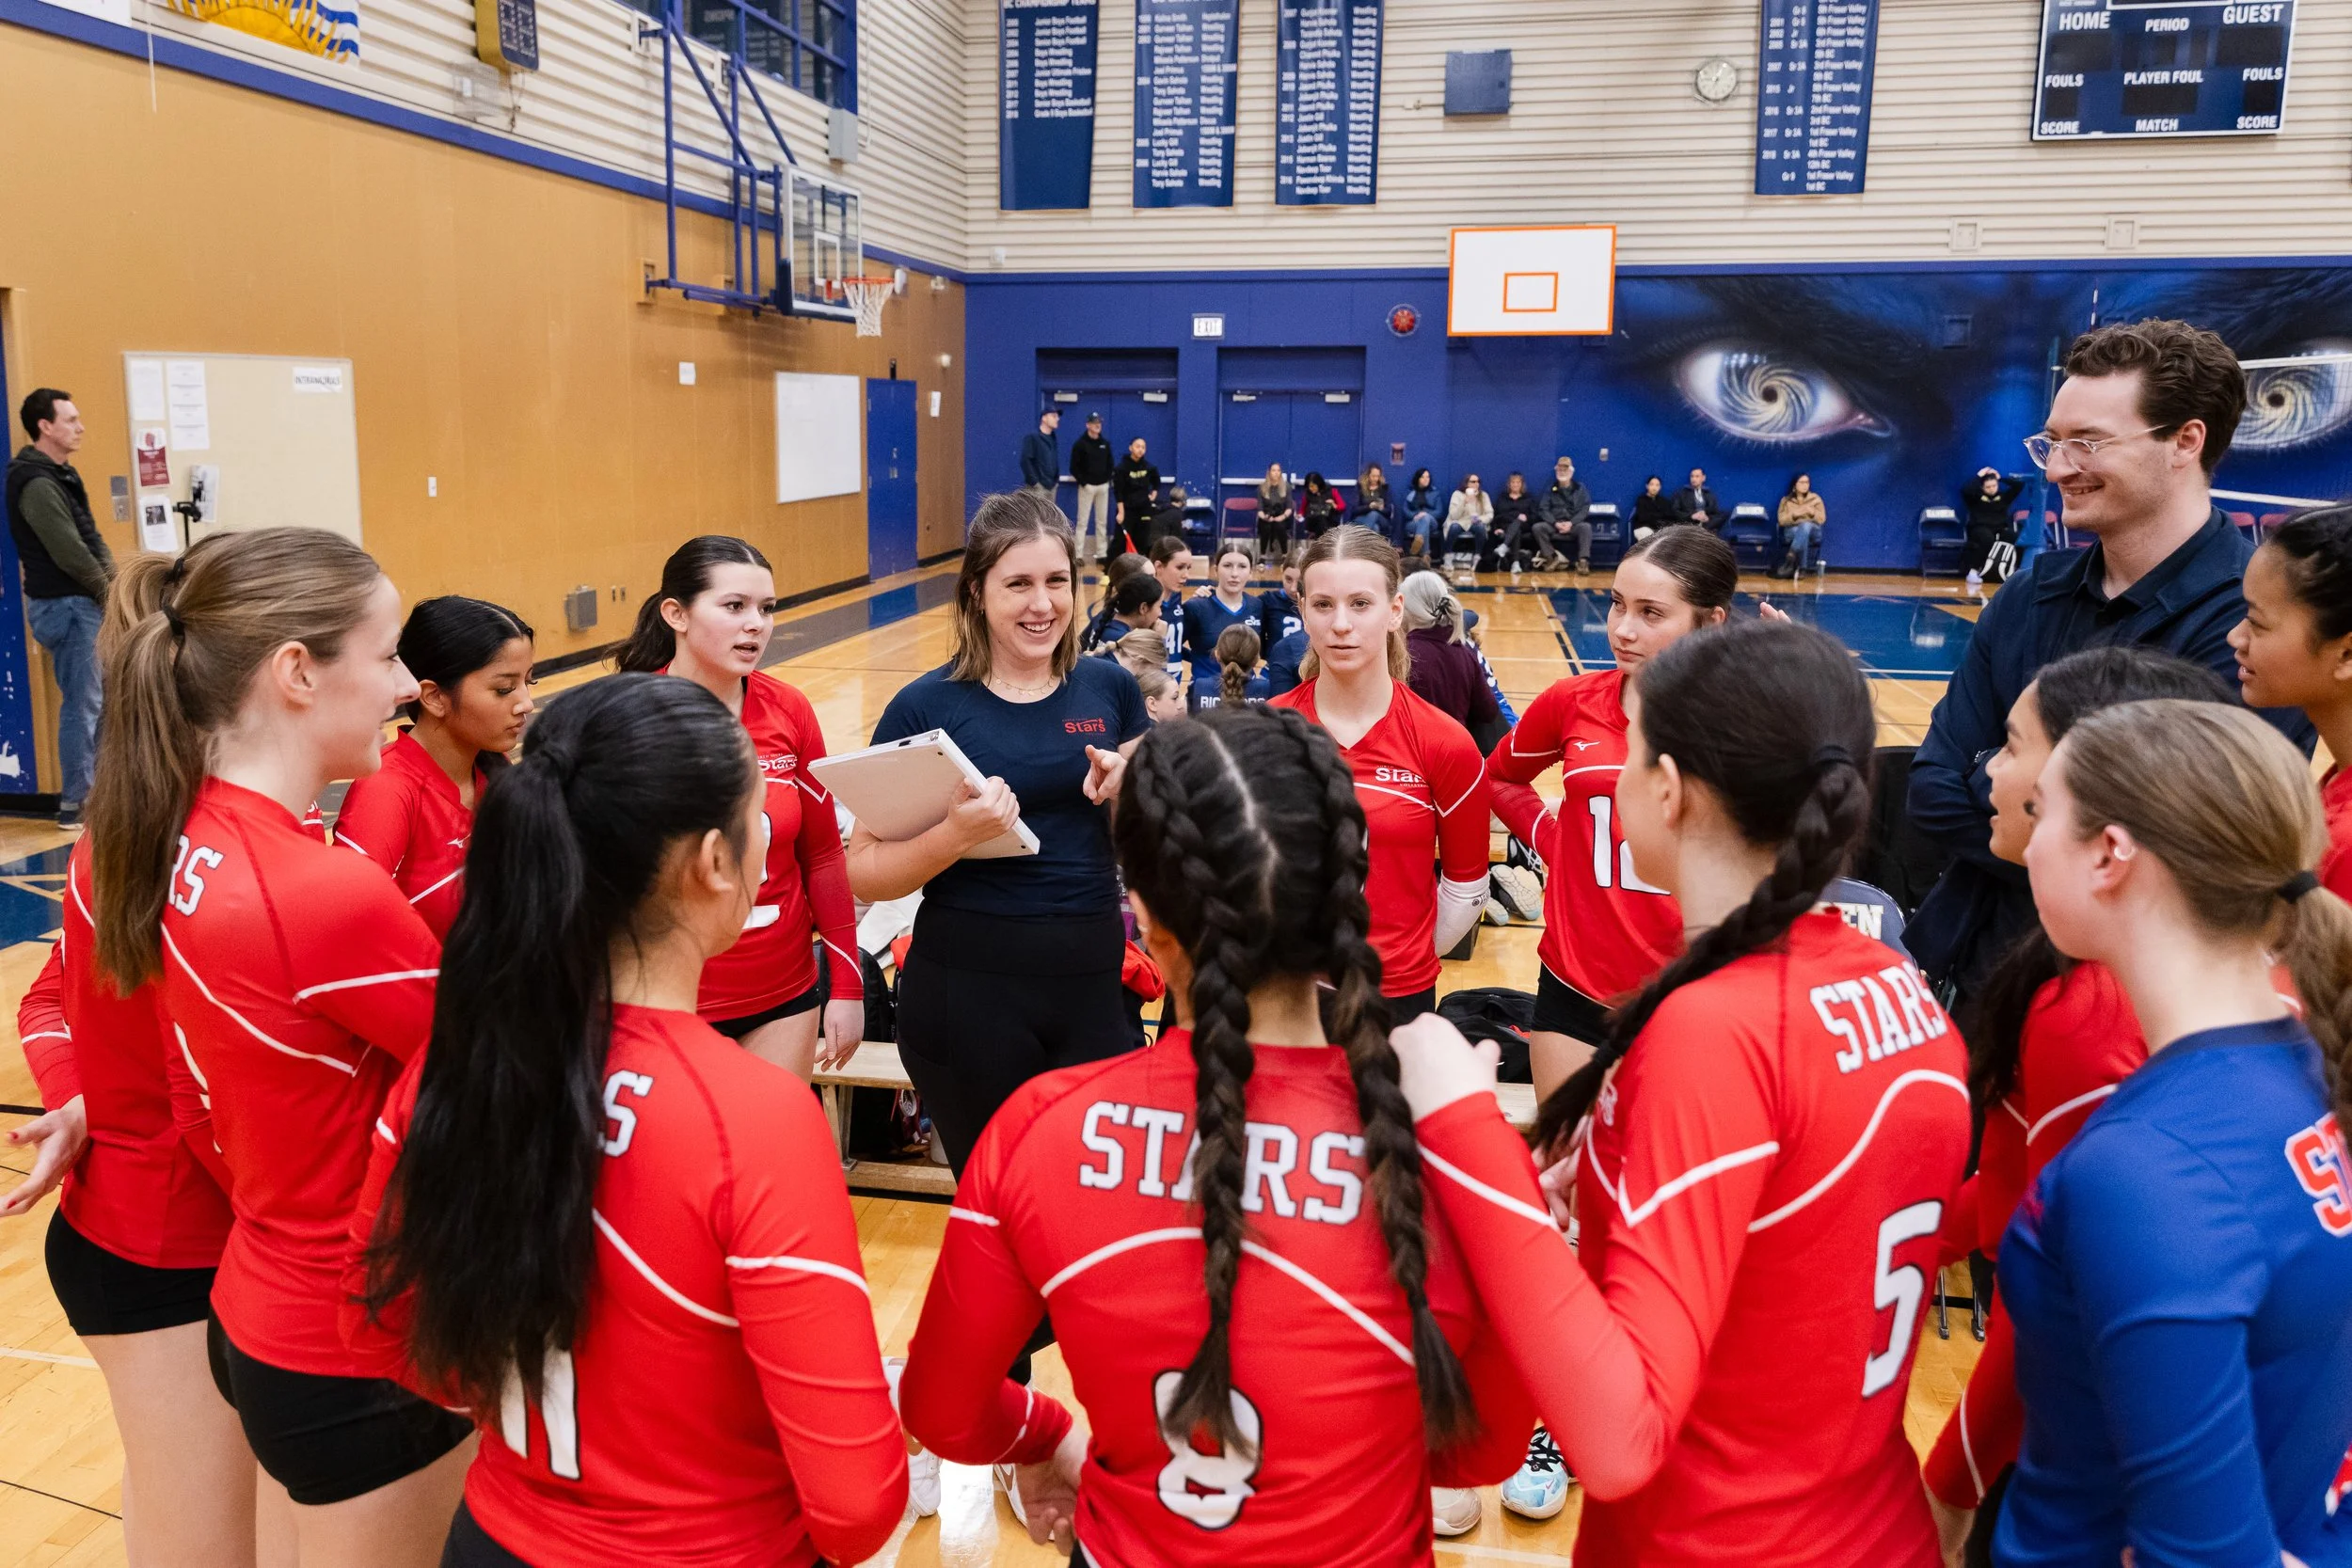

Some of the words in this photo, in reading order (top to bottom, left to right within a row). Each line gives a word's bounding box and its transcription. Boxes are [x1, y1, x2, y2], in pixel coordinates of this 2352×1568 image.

[2059, 11, 2110, 30] HOME
[2223, 5, 2283, 24] GUEST
[2145, 18, 2190, 32] PERIOD
[2045, 73, 2084, 87] FOULS
[2124, 71, 2170, 85] PLAYER
[2172, 70, 2203, 84] FOUL
[2243, 67, 2283, 81] FOULS
[2041, 120, 2079, 135] SCORE
[2136, 119, 2179, 132] MATCH
[2237, 115, 2278, 129] SCORE
[1064, 721, 1106, 734] Stars
[1375, 768, 1426, 783] Star
[1862, 1199, 1944, 1400] 5
